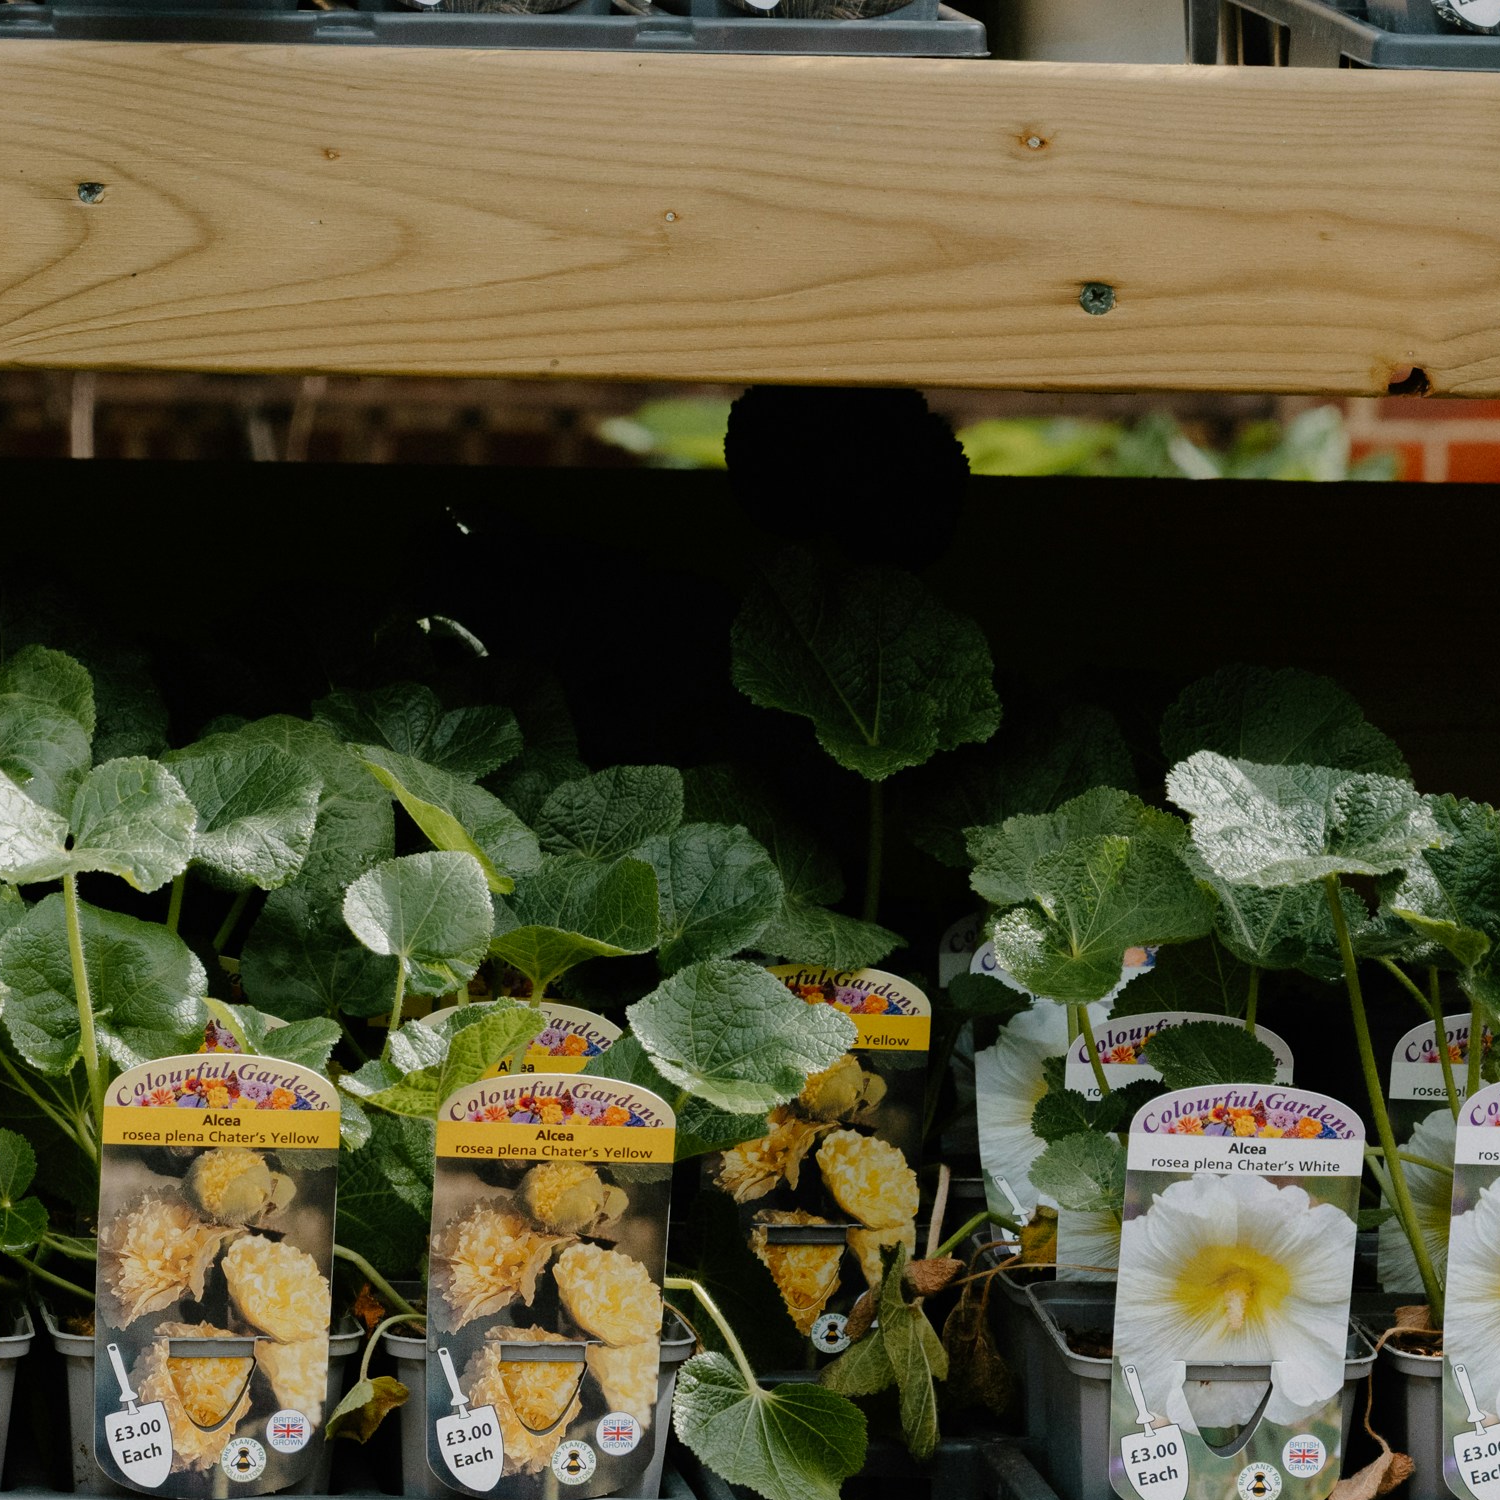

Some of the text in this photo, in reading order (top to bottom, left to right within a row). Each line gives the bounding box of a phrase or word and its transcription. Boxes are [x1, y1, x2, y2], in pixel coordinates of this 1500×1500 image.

[1142, 1090, 1356, 1140] Colourful Gardens
[1228, 1142, 1267, 1155] Alcea
[1151, 1157, 1341, 1172] rosea plena Chater's White
[1131, 1442, 1178, 1465] £3.00
[1138, 1465, 1179, 1487] Each
